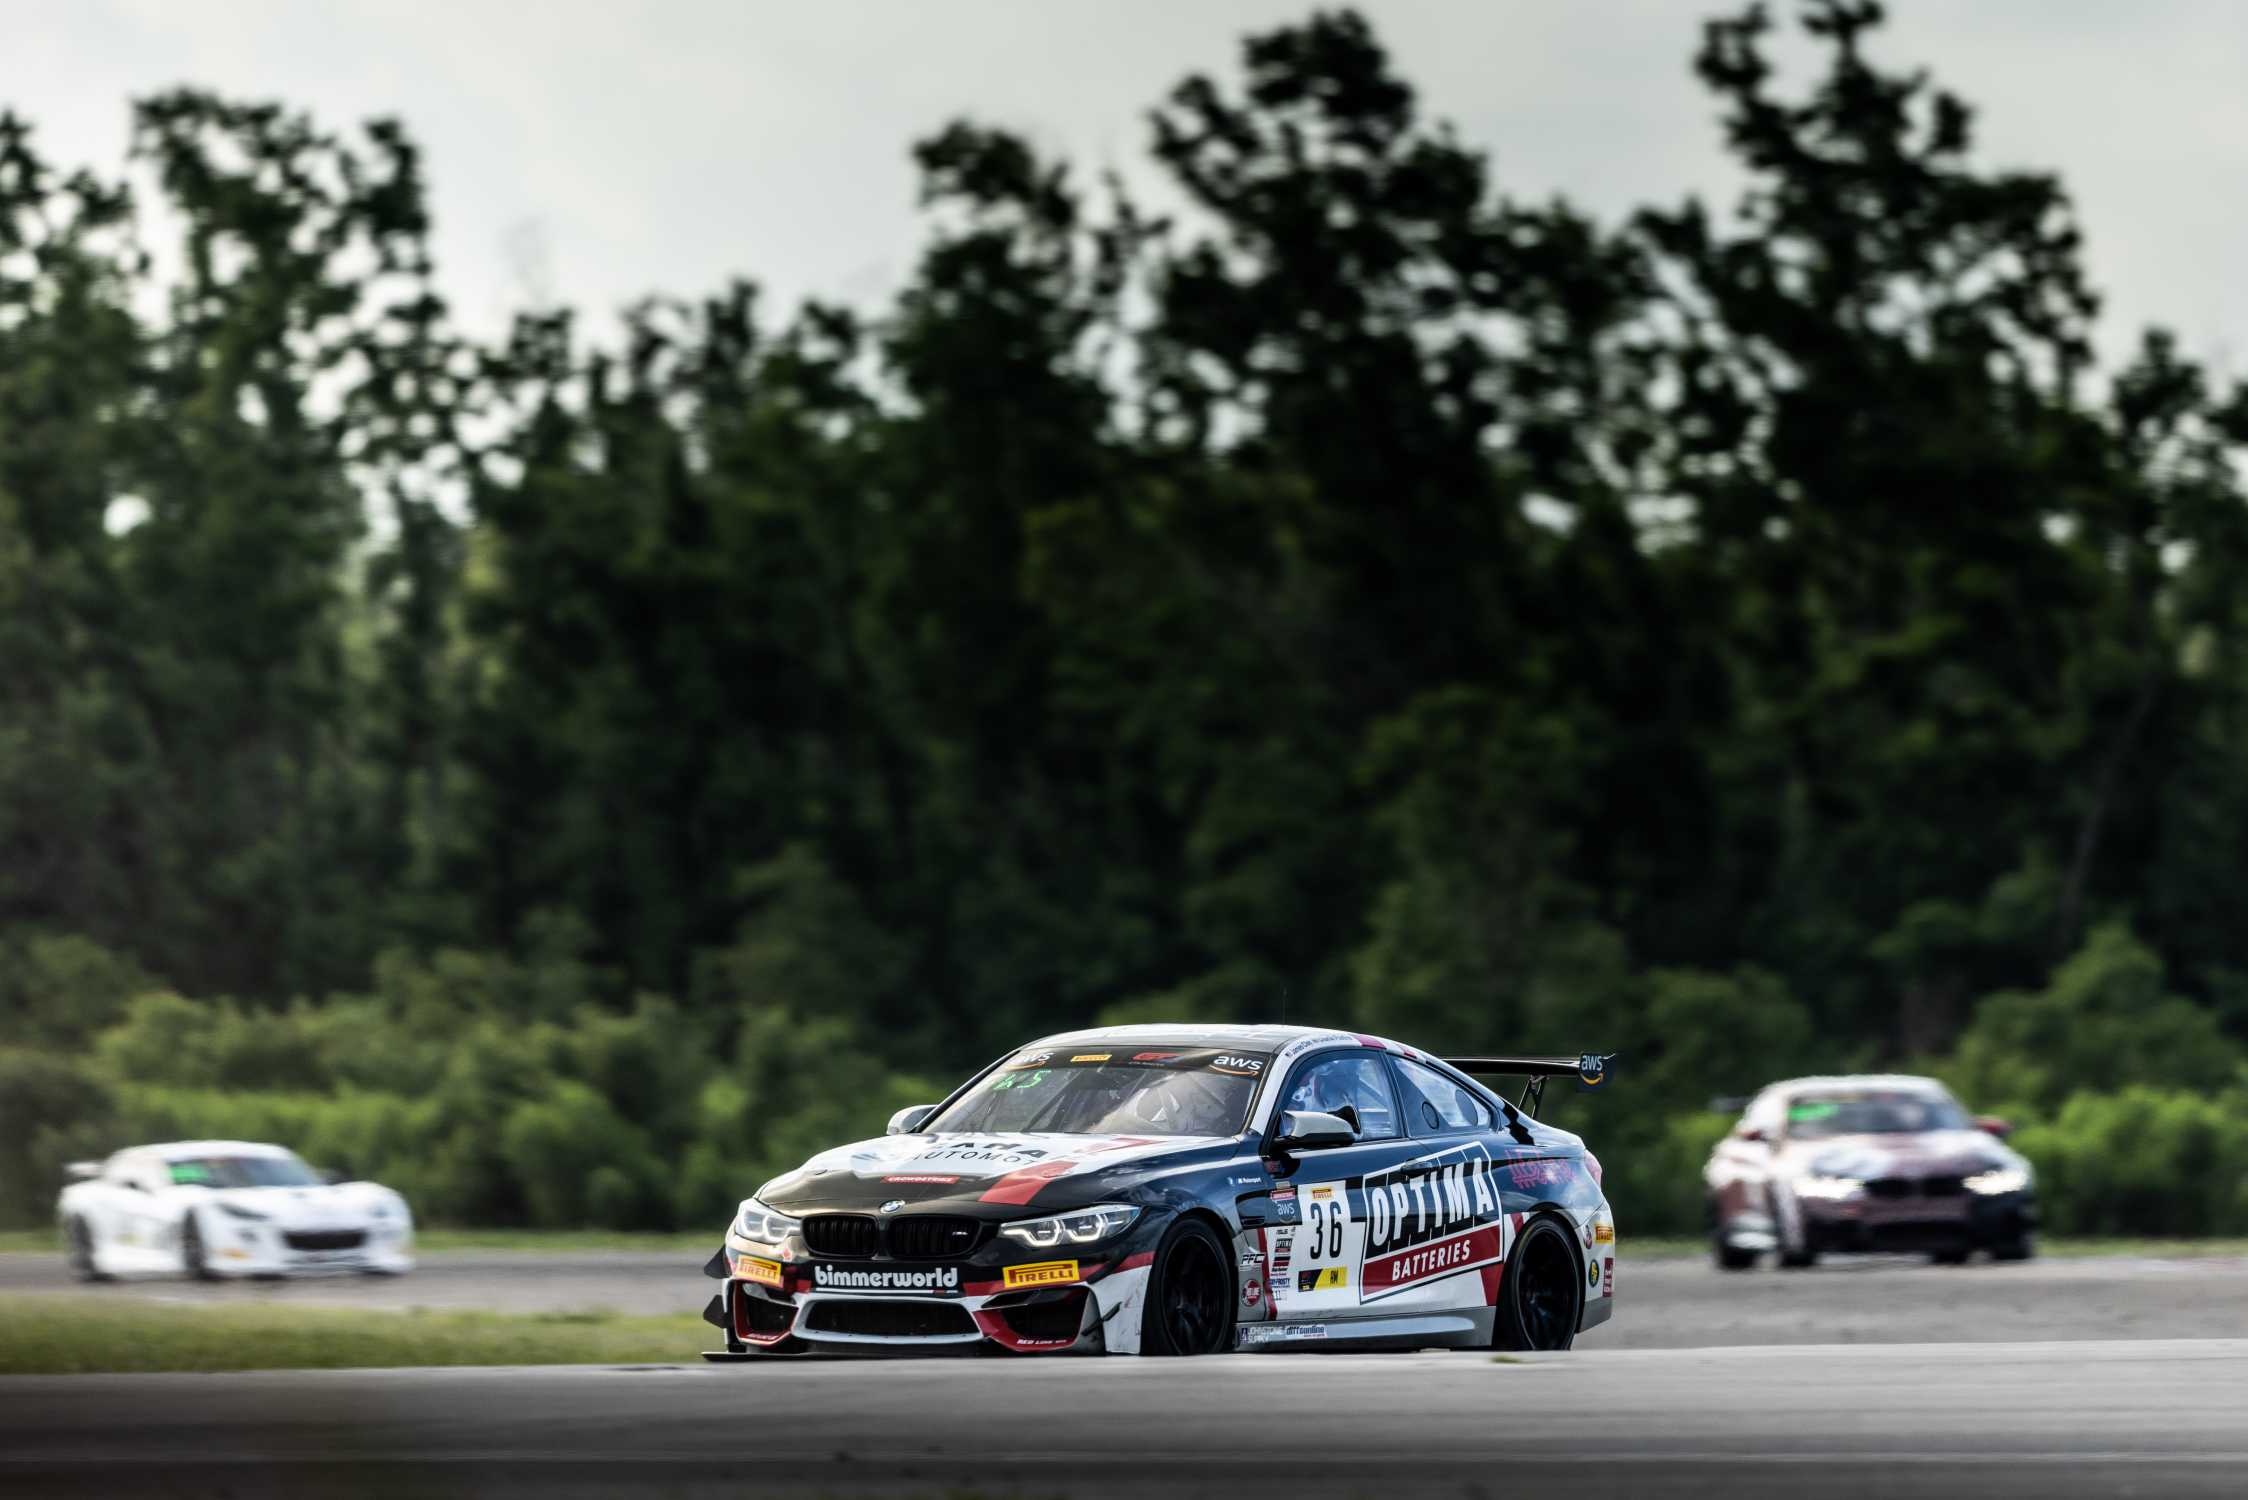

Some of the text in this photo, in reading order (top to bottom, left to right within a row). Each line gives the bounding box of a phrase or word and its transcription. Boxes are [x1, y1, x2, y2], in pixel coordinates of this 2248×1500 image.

[1213, 1055, 1263, 1071] aws
[1581, 1055, 1603, 1071] aws
[1276, 1202, 1295, 1216] aws
[1371, 1157, 1495, 1247] OPTIMA
[1309, 1201, 1342, 1259] 36
[740, 1258, 778, 1281] PIRELLI
[1242, 1253, 1265, 1264] PFC
[1391, 1240, 1471, 1281] BATTERIES
[814, 1264, 958, 1288] bimmerworld
[1007, 1263, 1074, 1284] PIRELLI
